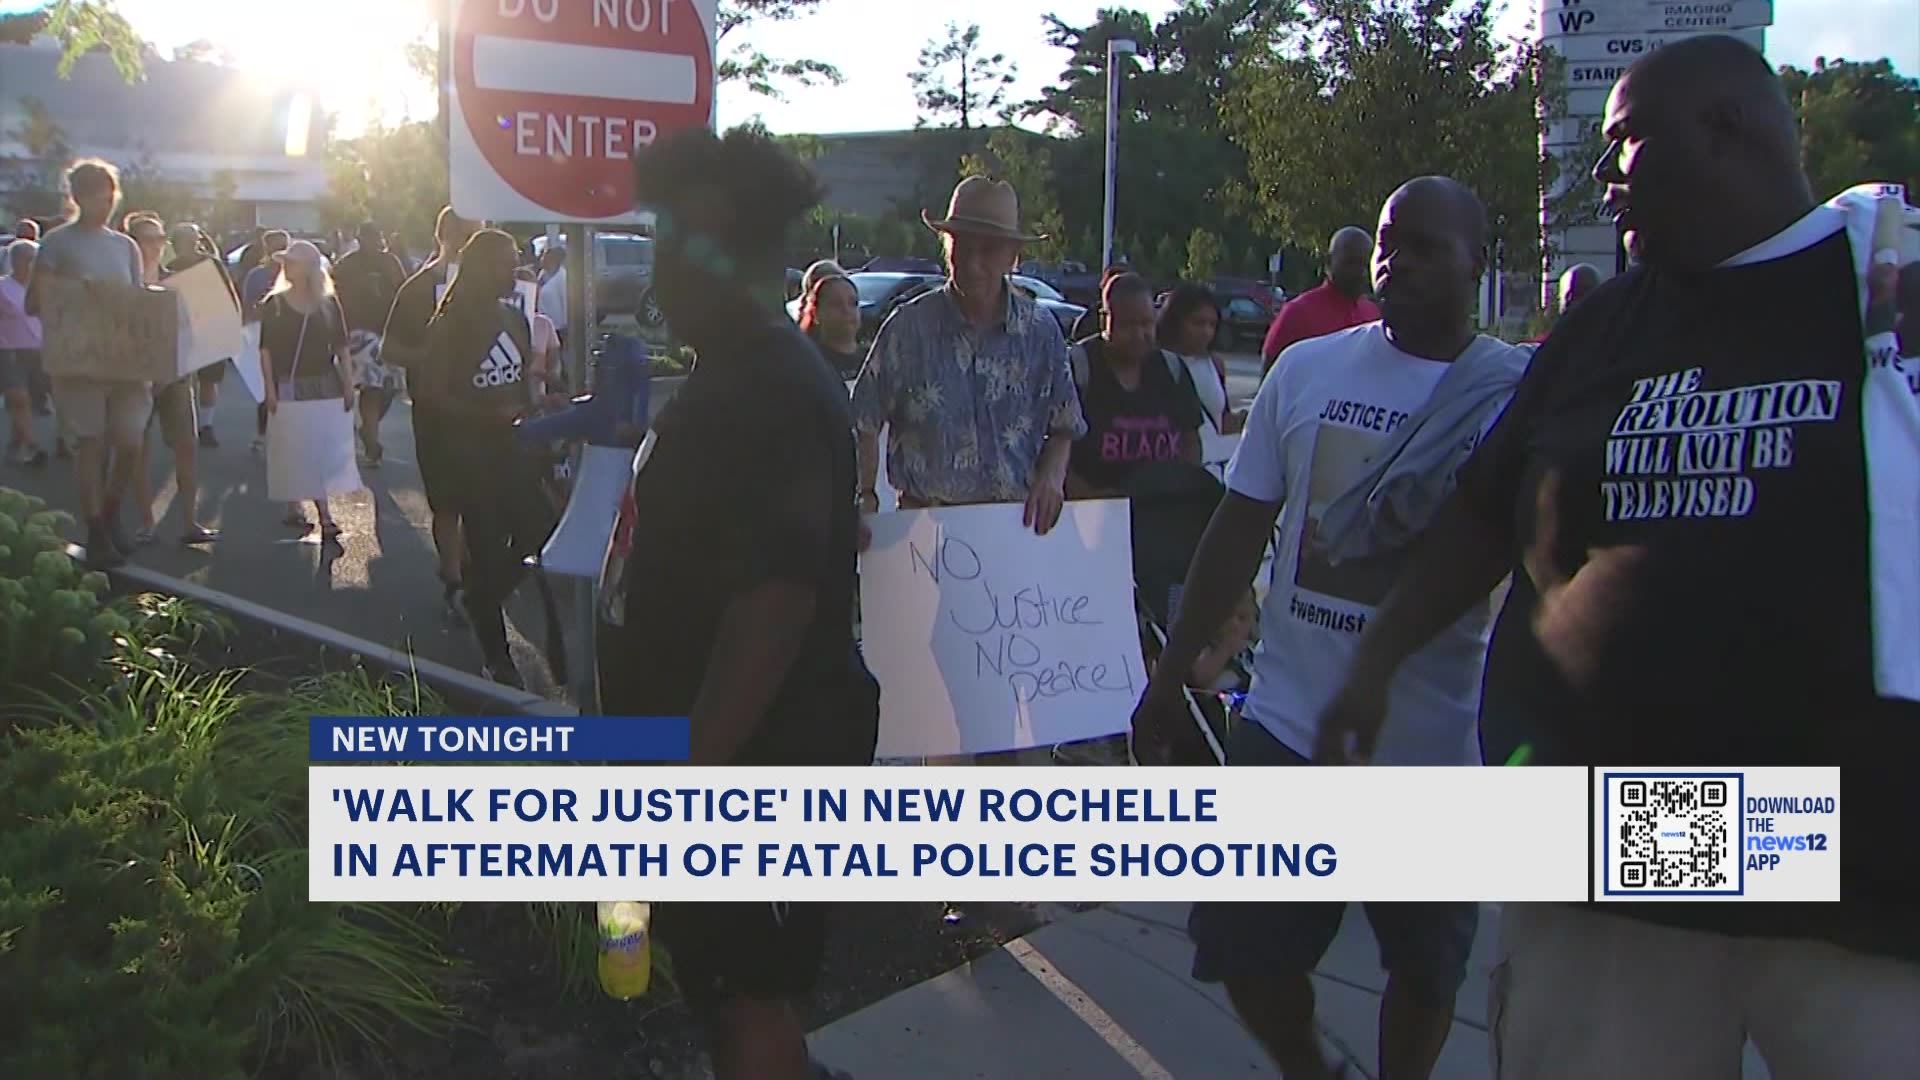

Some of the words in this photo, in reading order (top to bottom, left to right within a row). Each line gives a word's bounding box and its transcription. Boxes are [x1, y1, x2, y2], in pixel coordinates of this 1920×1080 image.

[593, 0, 675, 35] NOT
[1665, 4, 1733, 15] IMAGING
[1665, 16, 1727, 27] CENTER
[1607, 39, 1643, 54] CVS
[516, 111, 657, 159] ENTER
[1631, 367, 1702, 402] THE
[1319, 399, 1387, 431] JUSTICE
[1614, 382, 1839, 433] REVOLUTION
[1102, 431, 1181, 461] BLACK
[1605, 437, 1672, 475] WILL
[1680, 432, 1742, 471] NOT
[1751, 426, 1794, 469] BE
[1601, 476, 1755, 521] TELEVISED
[909, 523, 981, 584] NO
[950, 580, 1104, 634] Justice
[976, 634, 1041, 680] NO
